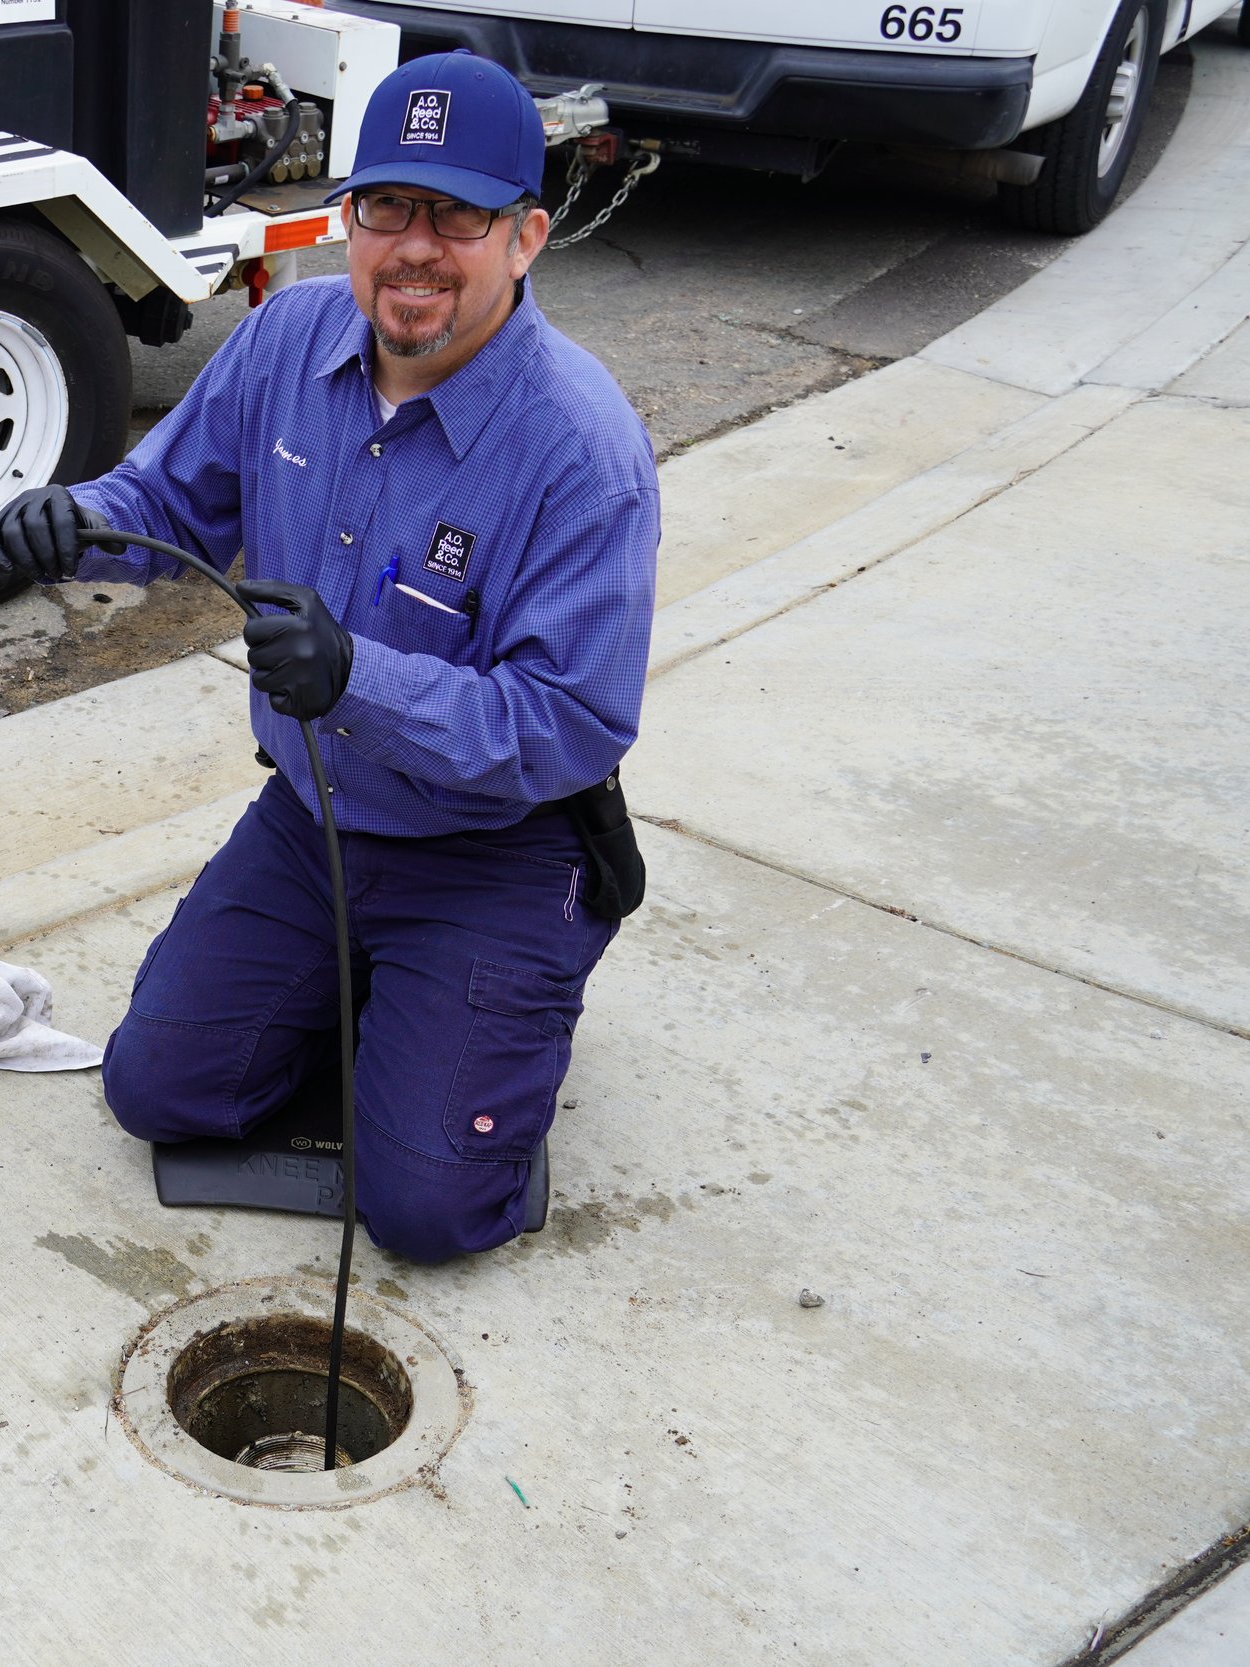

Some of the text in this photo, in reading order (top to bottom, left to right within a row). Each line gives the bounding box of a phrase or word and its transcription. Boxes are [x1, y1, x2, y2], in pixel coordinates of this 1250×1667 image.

[880, 4, 964, 43] 665
[417, 95, 438, 107] A.O.
[411, 107, 442, 119] Reed
[406, 132, 439, 140] SINCE 1914
[272, 437, 307, 467] James
[444, 531, 463, 547] A.O.
[437, 539, 465, 557] Reed
[427, 560, 462, 577] SINCE 1914
[315, 1140, 343, 1150] WOLV
[237, 1152, 319, 1182] KNEE
